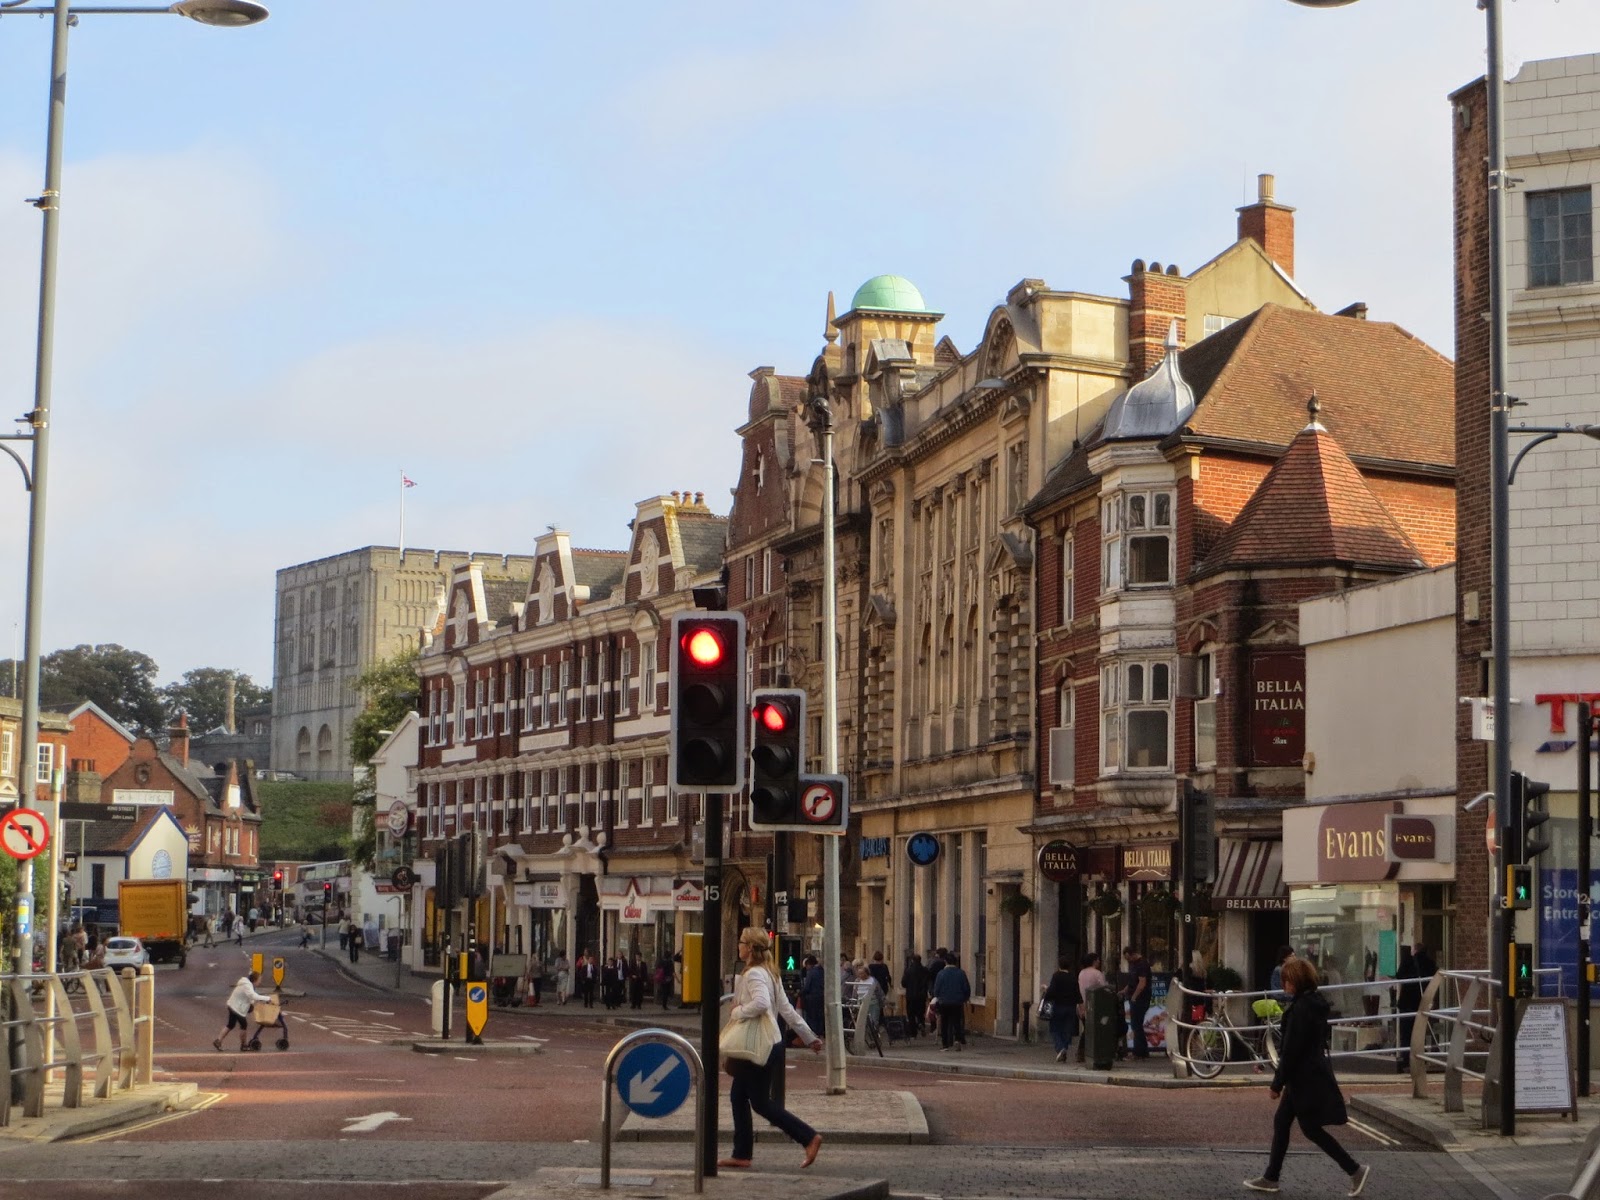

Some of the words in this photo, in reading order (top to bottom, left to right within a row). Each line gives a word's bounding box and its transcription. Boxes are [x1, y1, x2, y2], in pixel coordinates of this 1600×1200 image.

[1256, 680, 1303, 693] BELLA
[1255, 698, 1305, 711] ITALIA
[1325, 827, 1386, 860] Evans
[1395, 833, 1433, 843] Evans
[1045, 852, 1077, 862] BELLA
[1124, 850, 1145, 868] BELLA
[1147, 849, 1171, 867] ITALIA
[1043, 861, 1077, 870] ITALIA
[704, 885, 720, 901] 15
[1543, 885, 1579, 899] Store
[1226, 899, 1261, 909] BELLA
[1264, 899, 1288, 909] ITAL
[1184, 913, 1192, 923] 8
